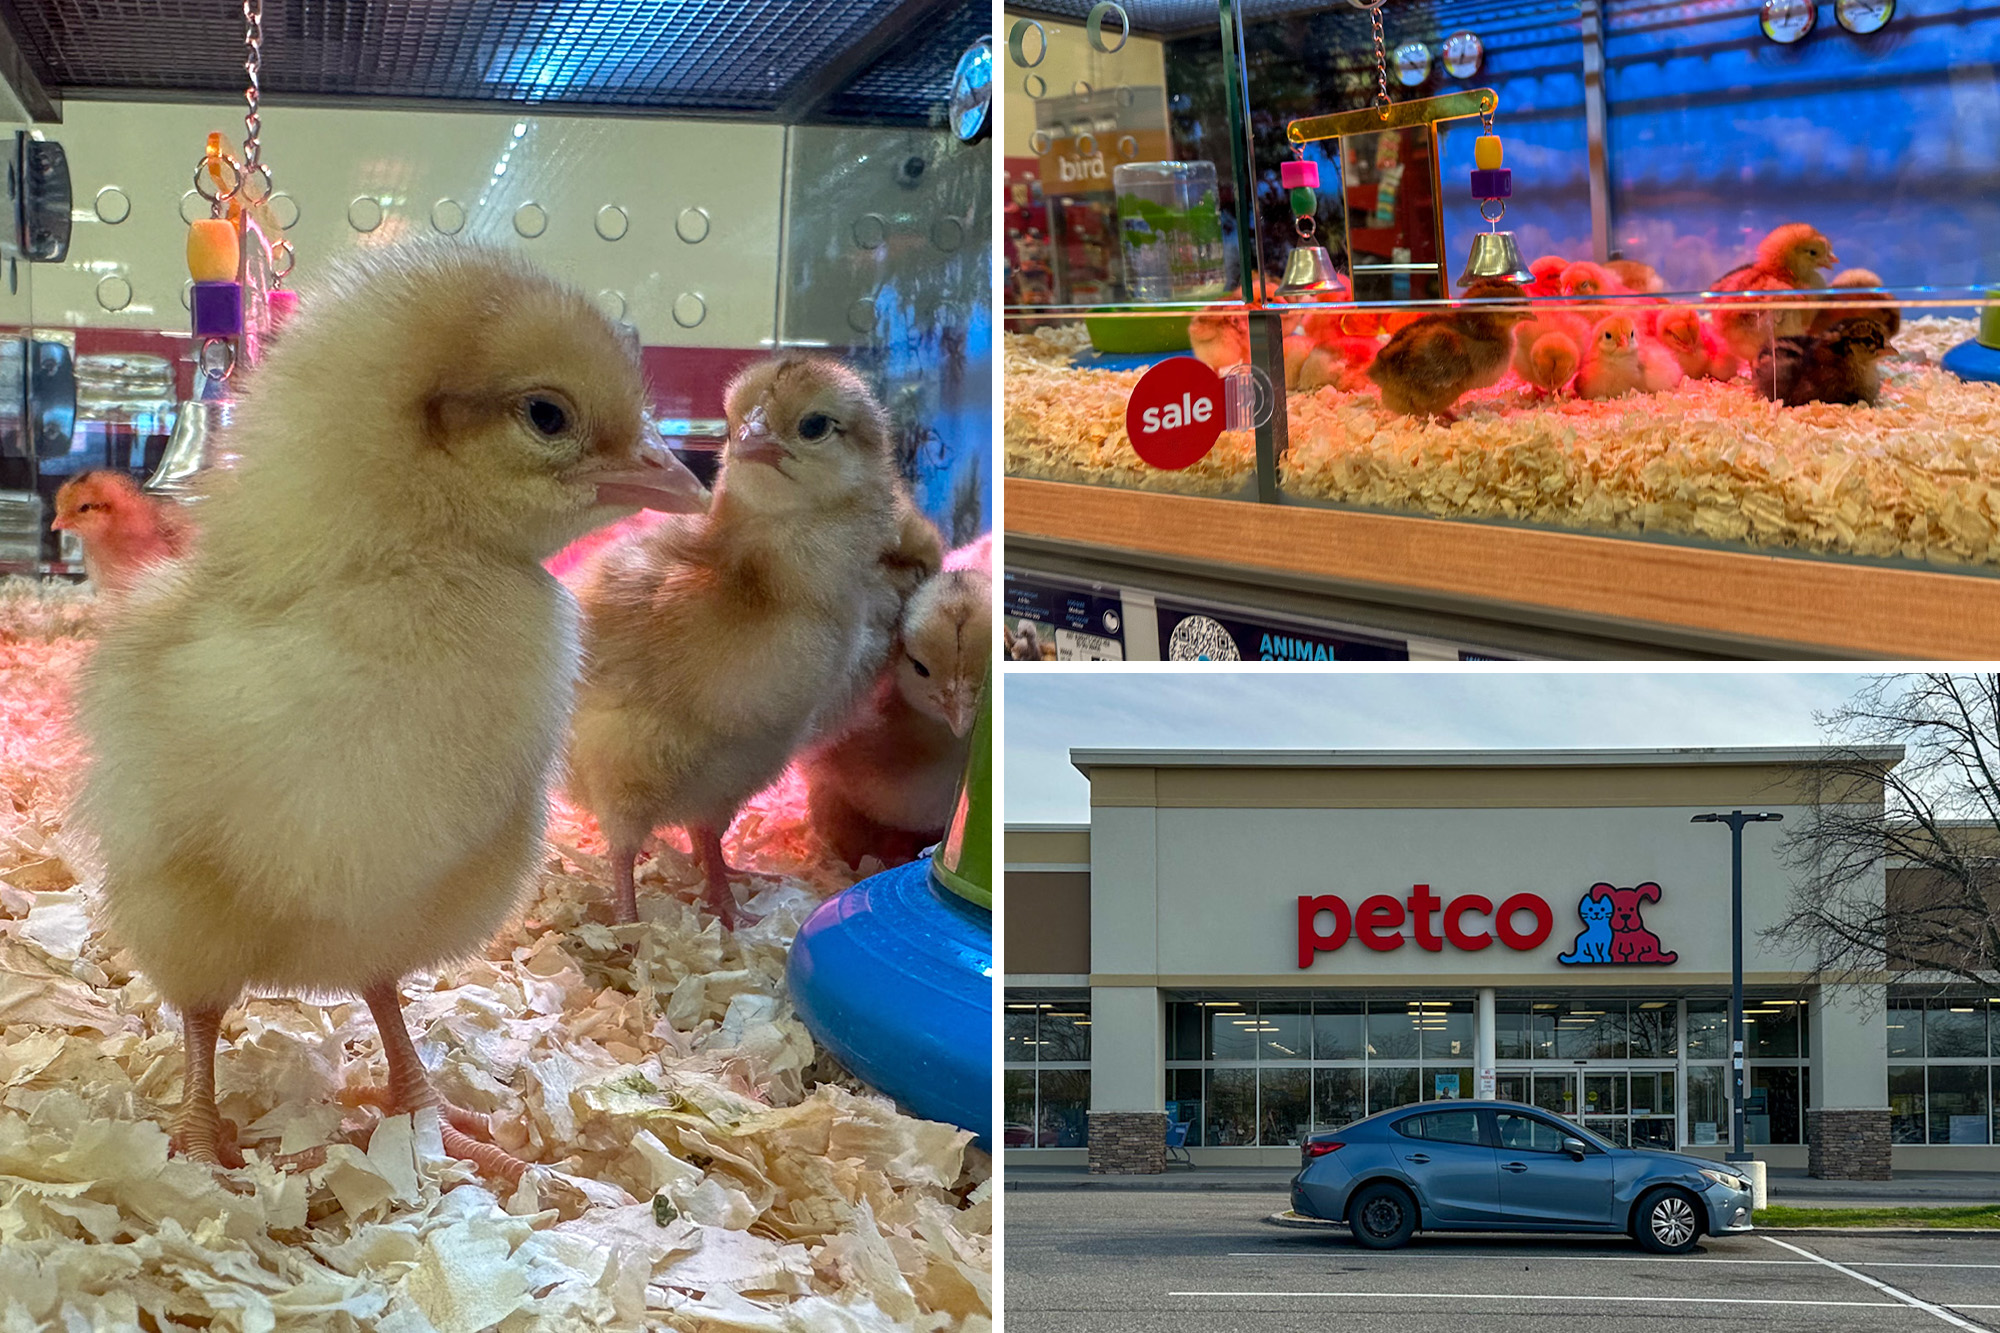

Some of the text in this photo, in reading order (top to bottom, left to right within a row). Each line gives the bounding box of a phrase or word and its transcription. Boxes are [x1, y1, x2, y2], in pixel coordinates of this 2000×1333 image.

[1059, 151, 1106, 182] bird
[1142, 392, 1213, 434] sale
[1298, 884, 1553, 968] petco
